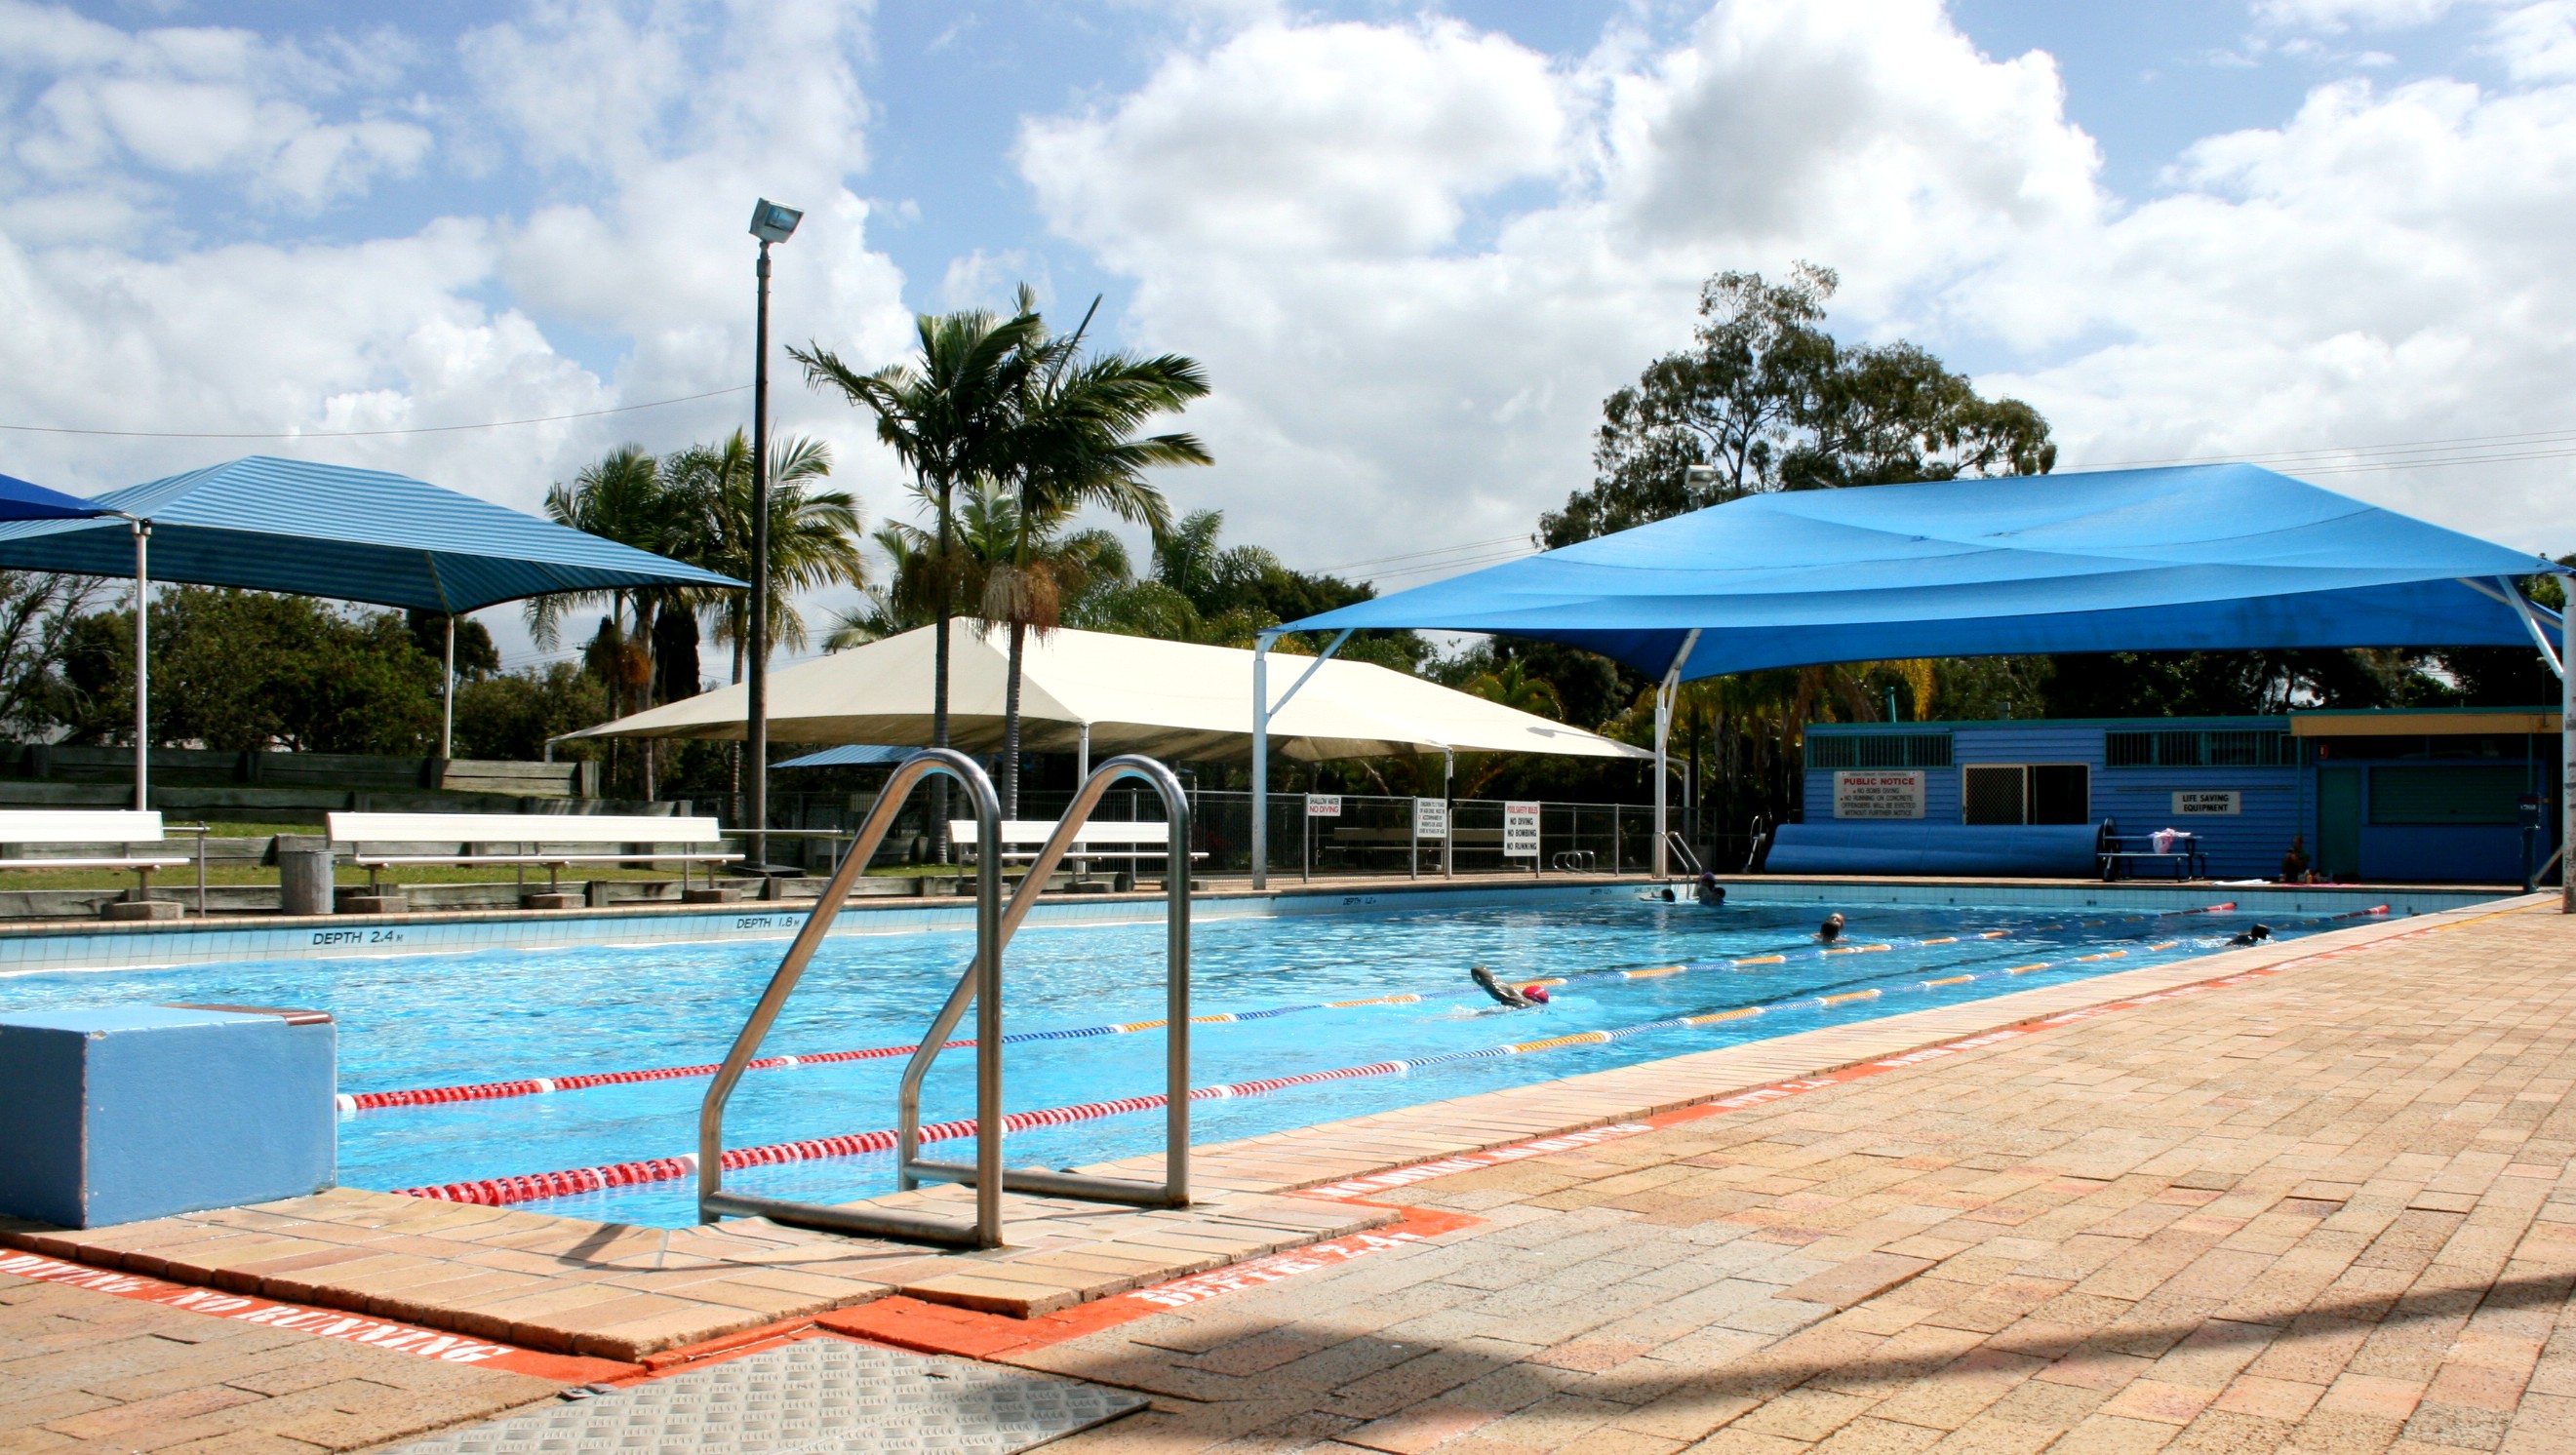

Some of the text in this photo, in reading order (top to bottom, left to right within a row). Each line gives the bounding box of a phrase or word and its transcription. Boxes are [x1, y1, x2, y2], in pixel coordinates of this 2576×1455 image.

[1506, 842, 1514, 850] NO
[737, 918, 773, 929] DEPTH
[312, 931, 363, 946] DEPTH
[150, 1290, 253, 1313] NO
[228, 1305, 514, 1362] RUNNING
